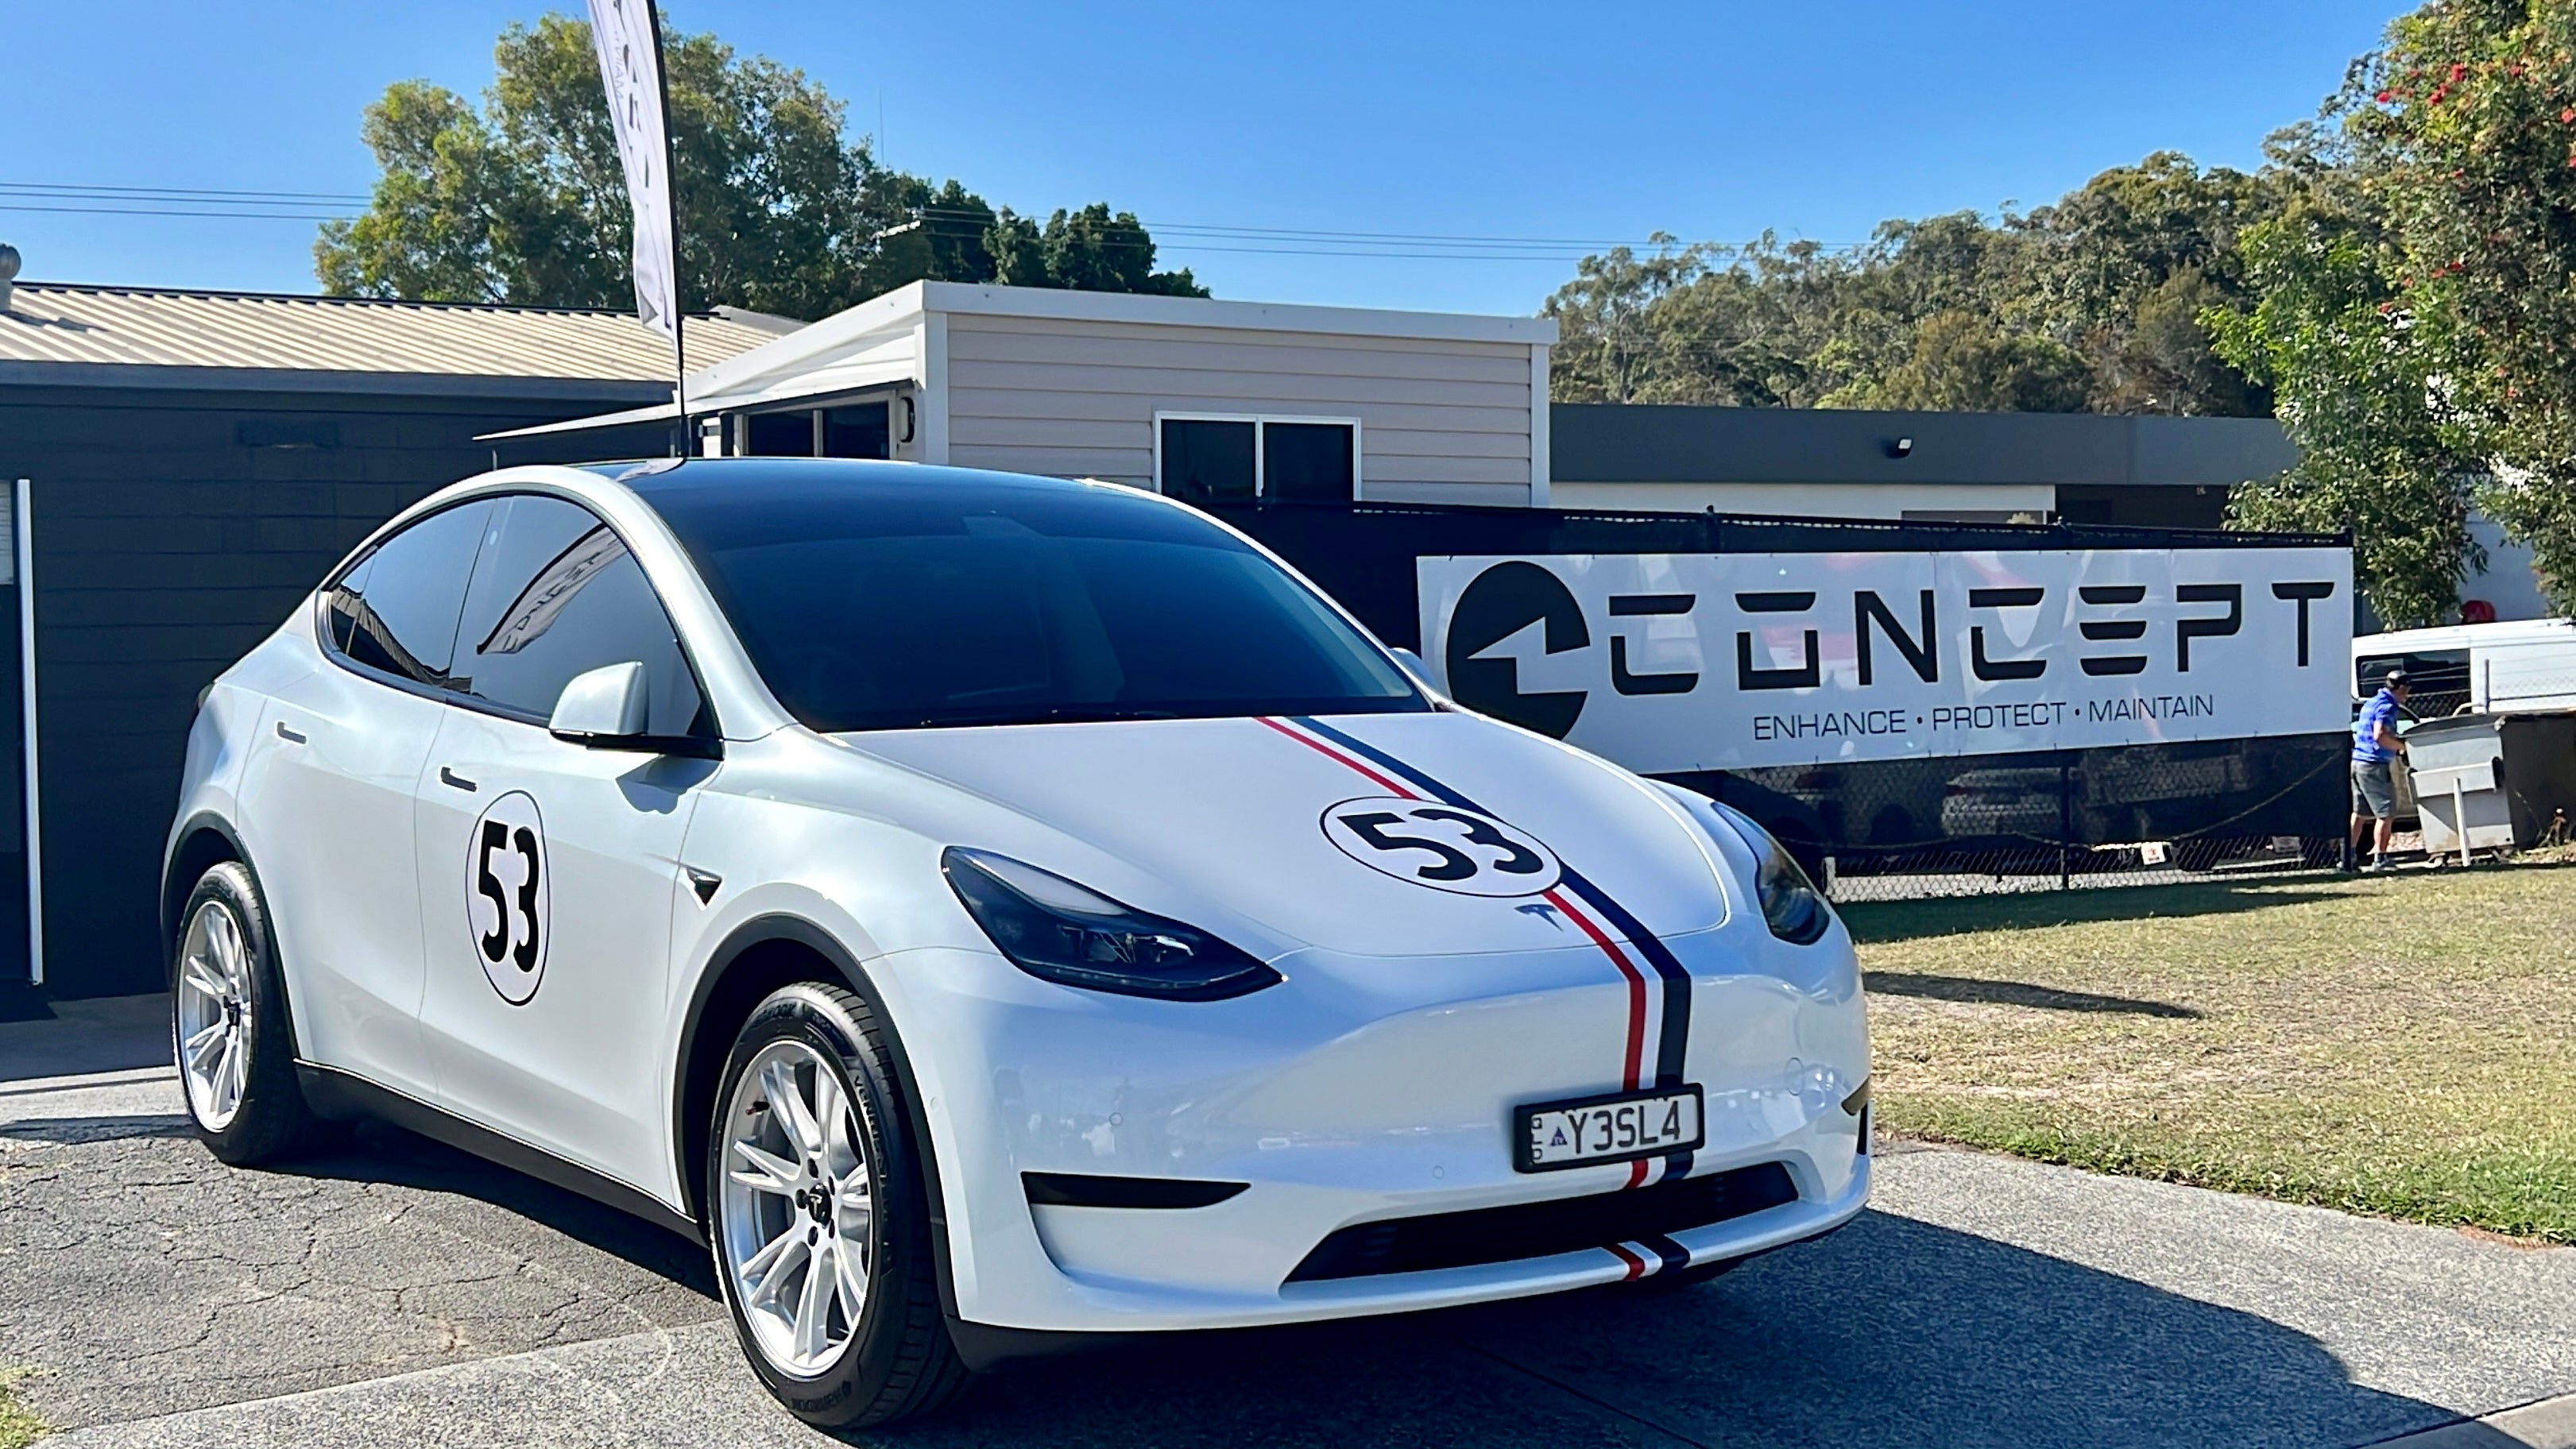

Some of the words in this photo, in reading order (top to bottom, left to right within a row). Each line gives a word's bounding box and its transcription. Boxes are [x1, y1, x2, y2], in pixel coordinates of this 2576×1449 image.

[1608, 581, 2335, 696] CONCEPT
[1753, 709, 1907, 740] ENHANCE
[1932, 701, 2067, 732] PROTECT
[2088, 694, 2214, 722] MAINTAIN
[1336, 808, 1544, 881] 53
[478, 819, 540, 973] 53
[1568, 1100, 1681, 1155] Y3SL4
